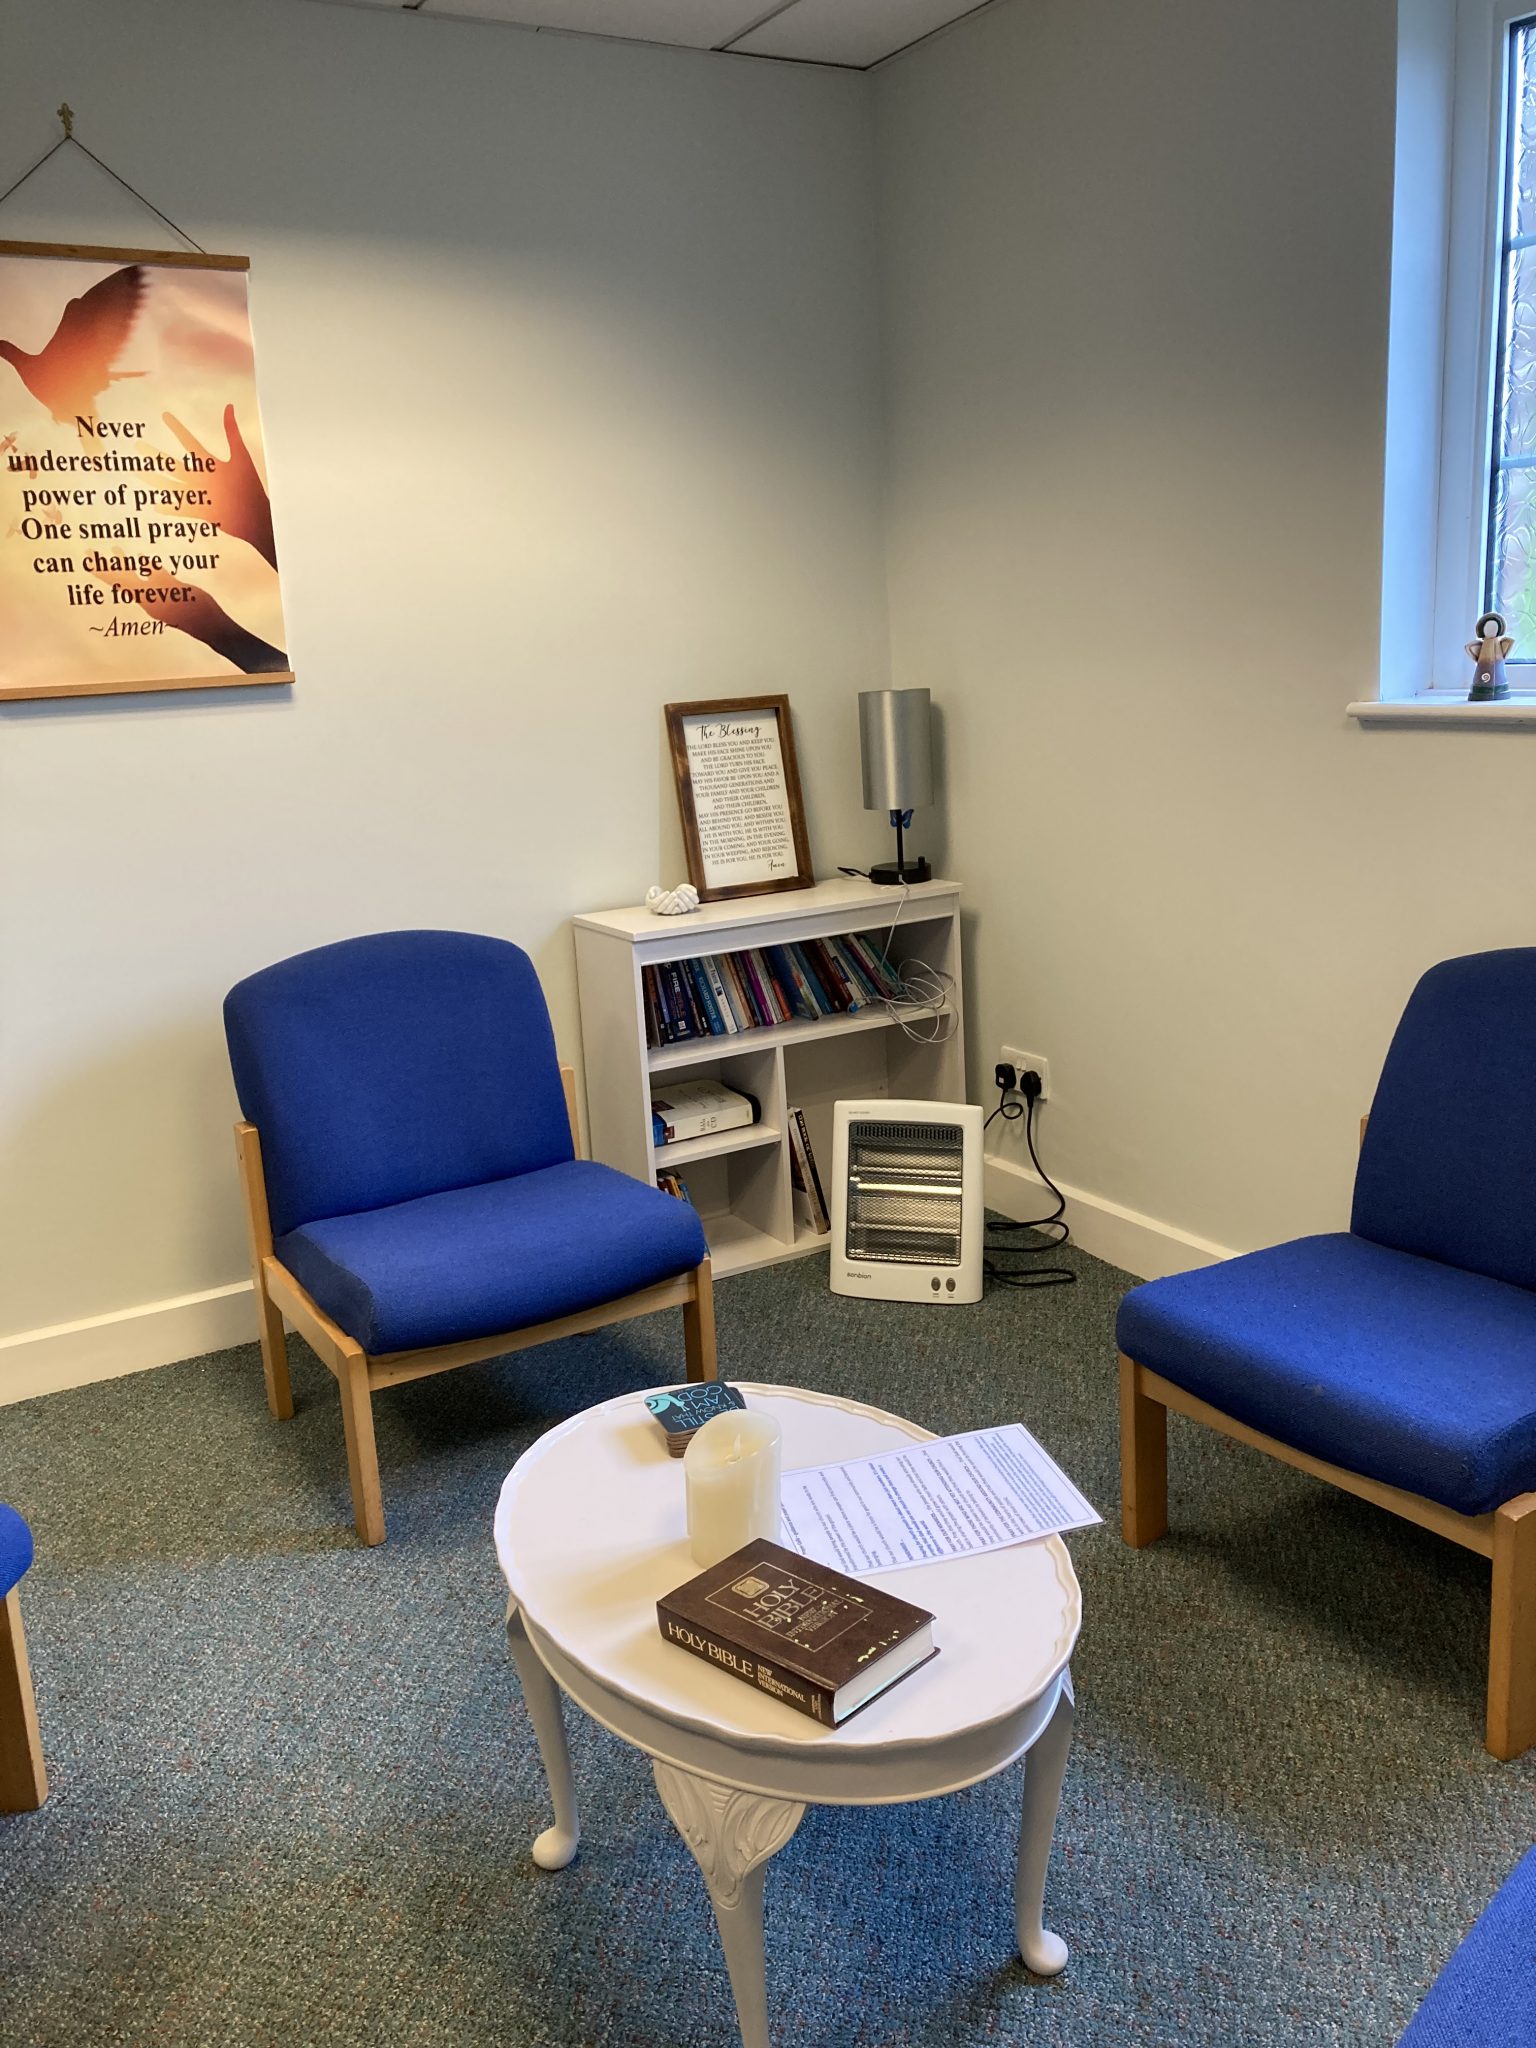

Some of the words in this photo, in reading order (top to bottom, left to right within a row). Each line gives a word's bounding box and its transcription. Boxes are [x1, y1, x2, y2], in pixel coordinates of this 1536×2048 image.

[76, 416, 146, 438] Never
[8, 450, 176, 472] underestimate
[183, 452, 216, 472] the
[22, 489, 96, 512] power
[104, 484, 128, 505] of
[134, 489, 212, 510] prayer.
[21, 518, 72, 540] One
[79, 518, 141, 539] small
[148, 521, 221, 544] prayer
[33, 556, 74, 573] can
[82, 551, 162, 576] change
[169, 553, 220, 574] your
[68, 584, 104, 606] life
[111, 584, 196, 604] forever.
[696, 725, 714, 741] The
[717, 723, 762, 738] Blessing
[678, 1385, 722, 1402] GOD
[691, 1395, 719, 1410] AM
[743, 1579, 800, 1618] HOLY
[758, 1586, 826, 1630] BIBLE
[668, 1622, 706, 1650] HOLY
[708, 1642, 754, 1678] BIBLE
[758, 1664, 773, 1678] NEW
[758, 1672, 806, 1702] INTERNATIONAL
[758, 1680, 784, 1697] VERSION
